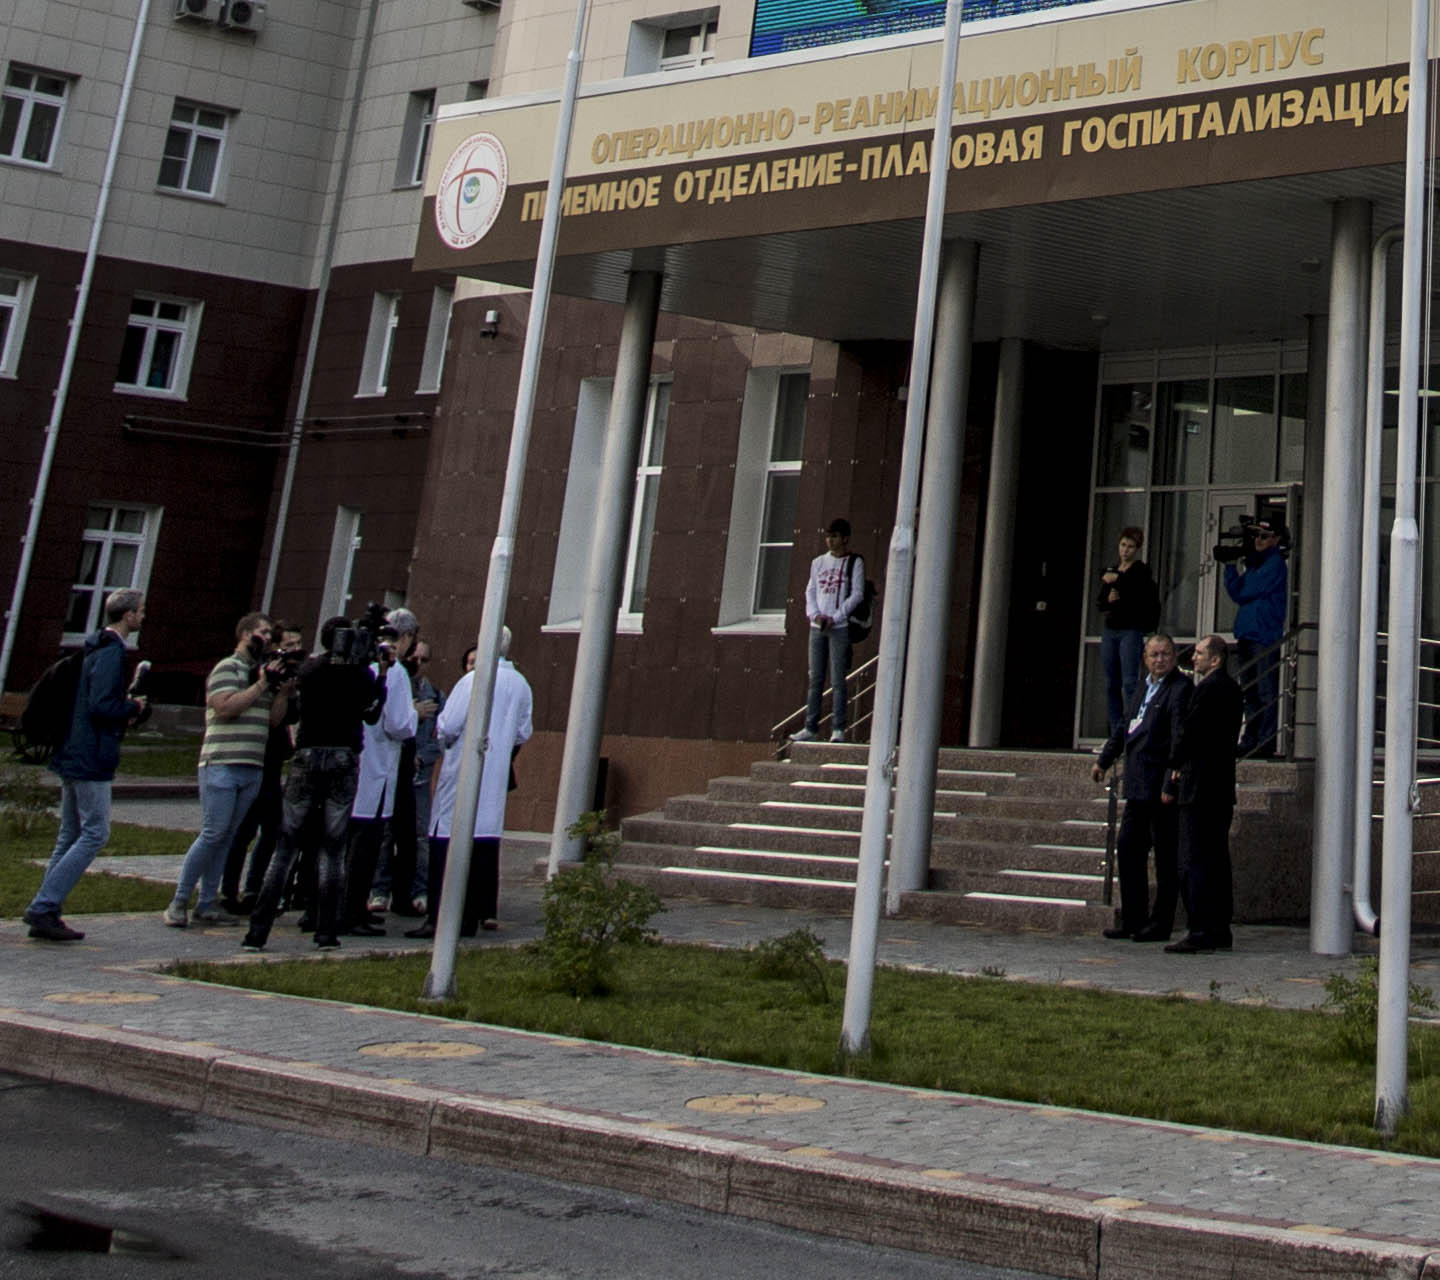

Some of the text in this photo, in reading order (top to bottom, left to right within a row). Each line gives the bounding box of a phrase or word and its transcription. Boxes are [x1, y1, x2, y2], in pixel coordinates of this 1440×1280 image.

[1176, 27, 1326, 85] КОРПУС
[520, 175, 662, 222] ПИЕМНОЕ
[673, 124, 1044, 204] ОТДЕЛЕНИЕ-ПЛАОВАЯ
[1062, 74, 1410, 157] ГОСПИТАЛИЗАЦИЯ
